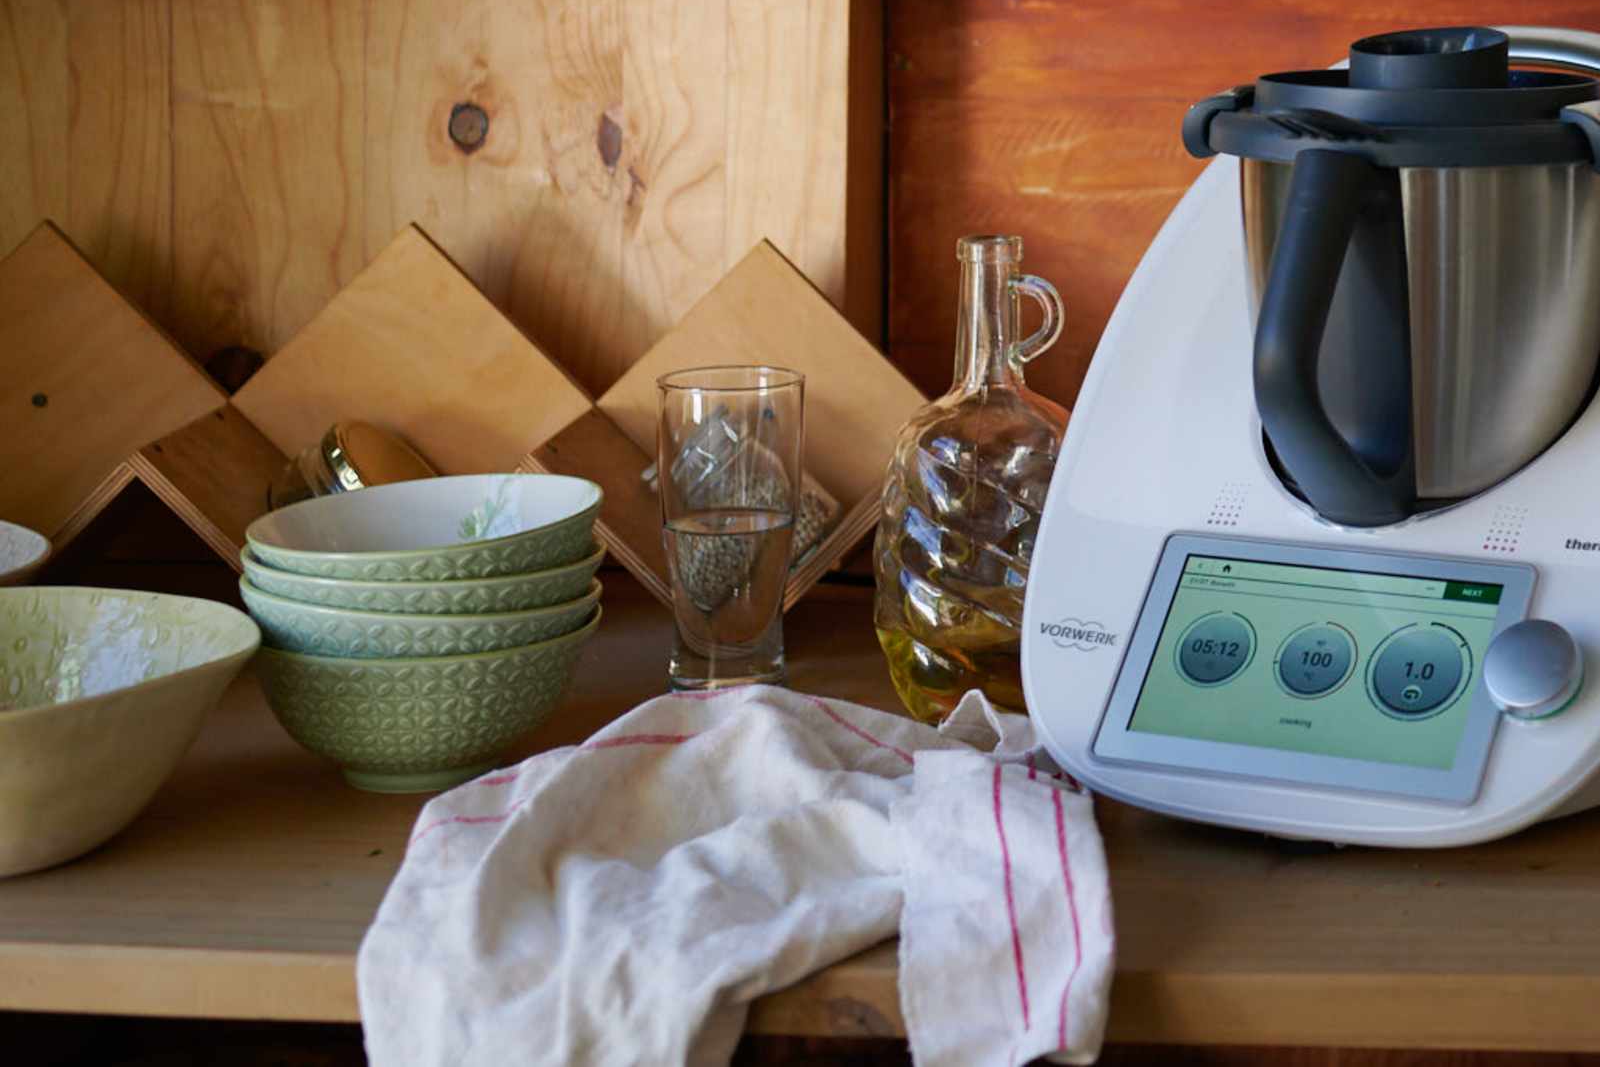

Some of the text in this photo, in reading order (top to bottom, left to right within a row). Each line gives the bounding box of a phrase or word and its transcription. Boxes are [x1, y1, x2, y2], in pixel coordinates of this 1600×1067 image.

[1040, 622, 1117, 646] VORWERK
[1192, 638, 1239, 658] 05:12
[1302, 651, 1333, 668] 100
[1405, 661, 1435, 680] 1.0
